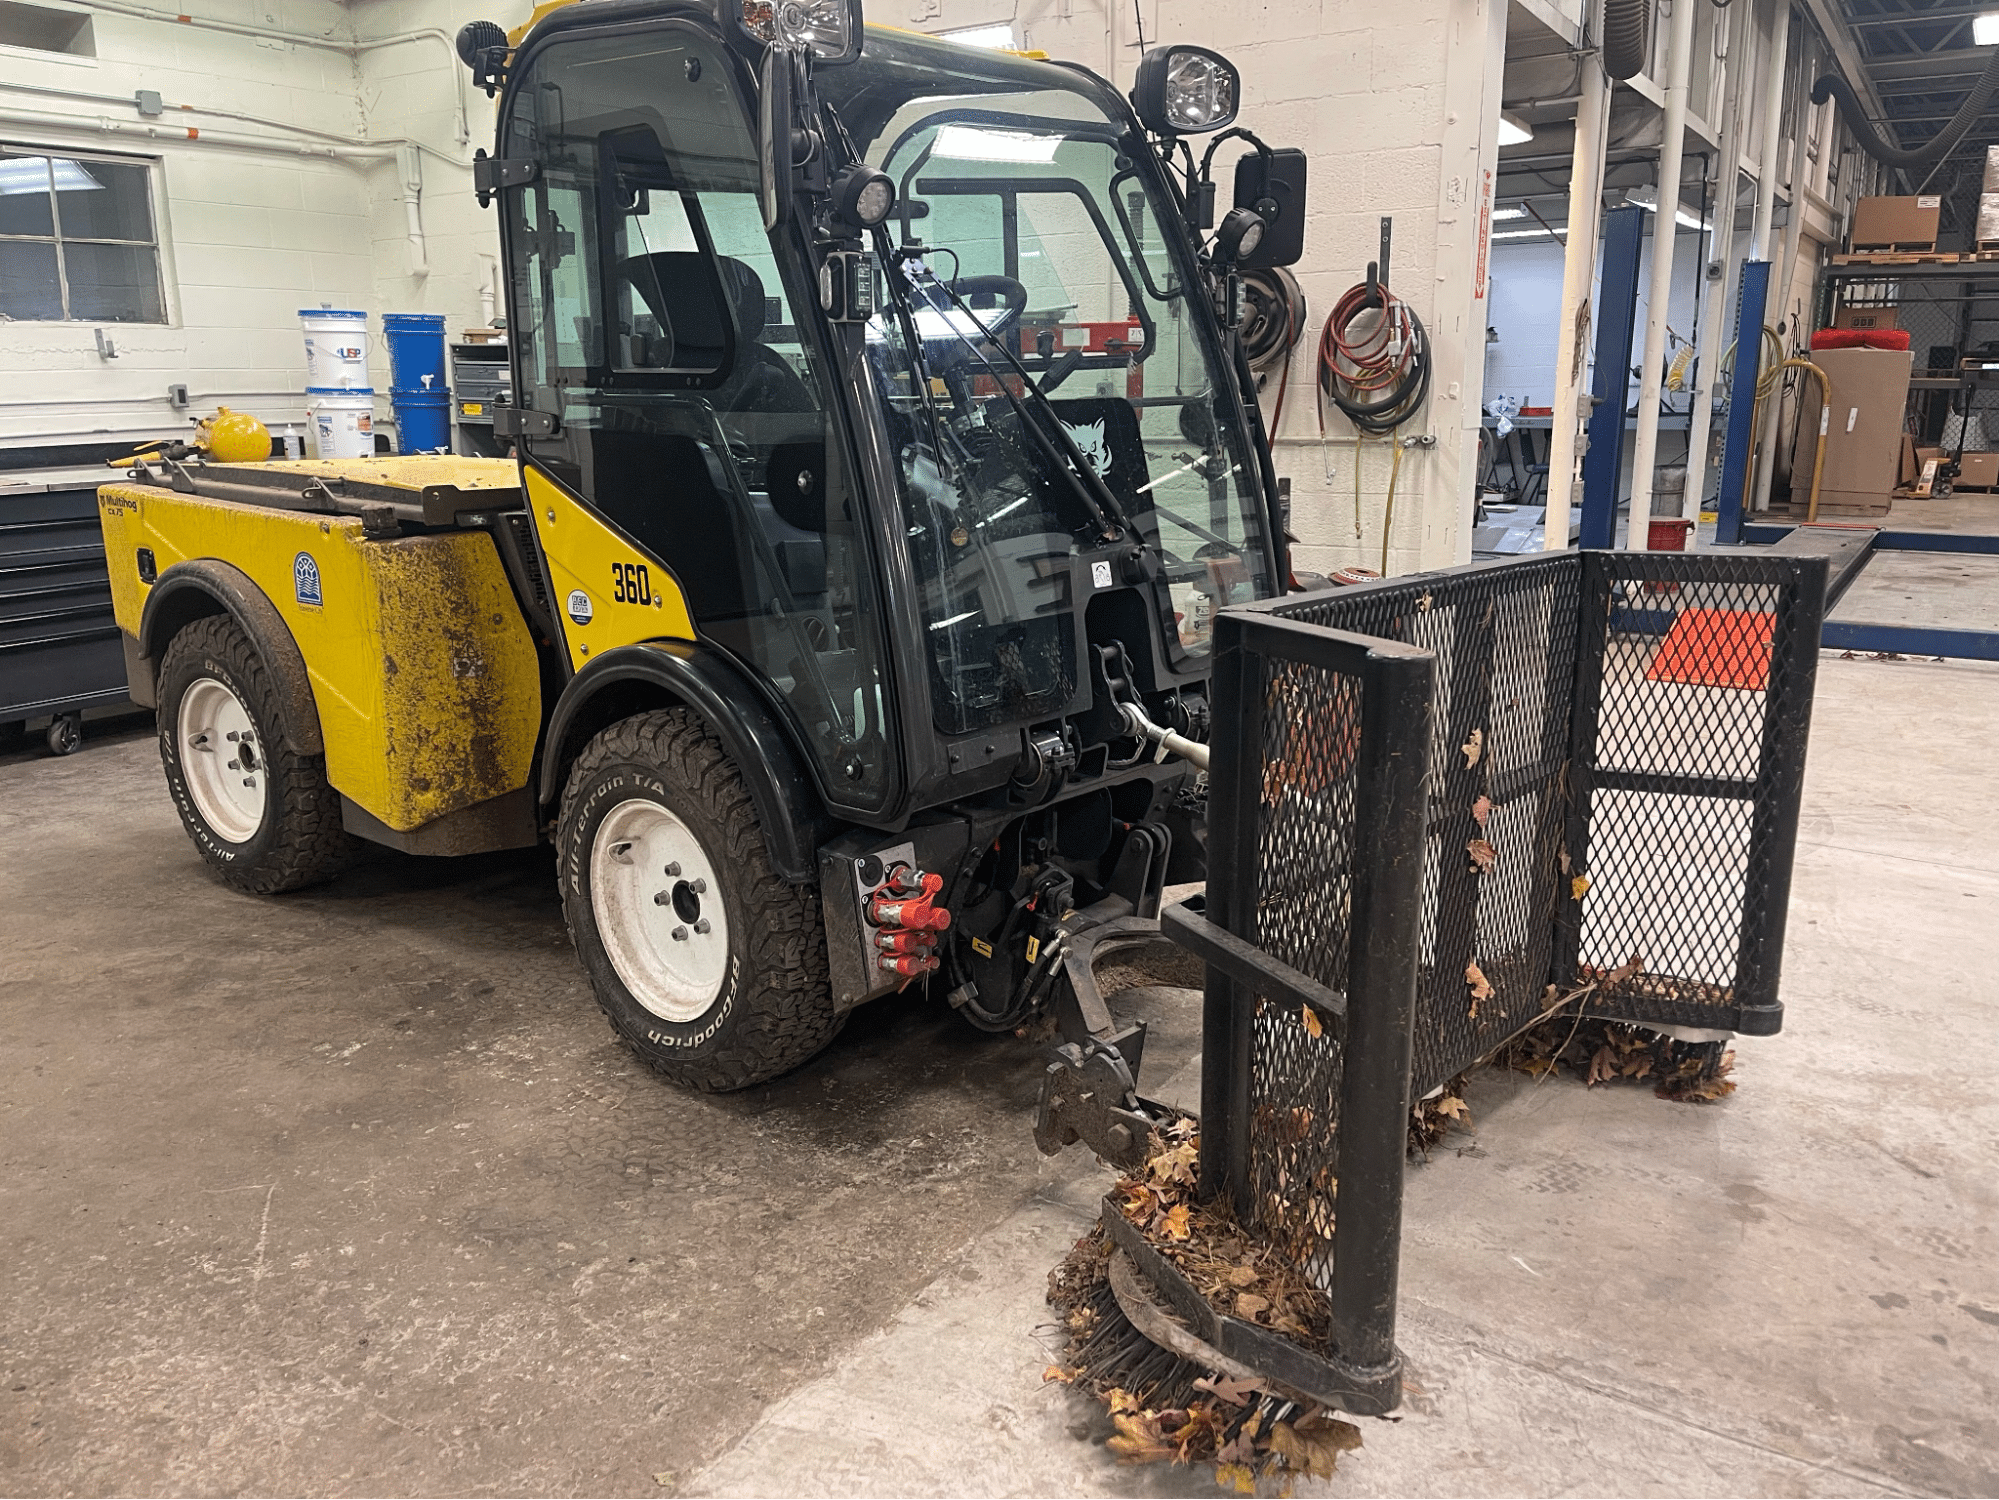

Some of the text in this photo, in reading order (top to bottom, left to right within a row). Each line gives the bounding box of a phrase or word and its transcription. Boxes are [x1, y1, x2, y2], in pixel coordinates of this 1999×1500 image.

[340, 347, 361, 358] USP
[106, 495, 137, 512] Multihog
[611, 562, 652, 606] 360
[570, 772, 665, 896] All-Terrain T/A
[647, 954, 741, 1050] BFGoodrich
